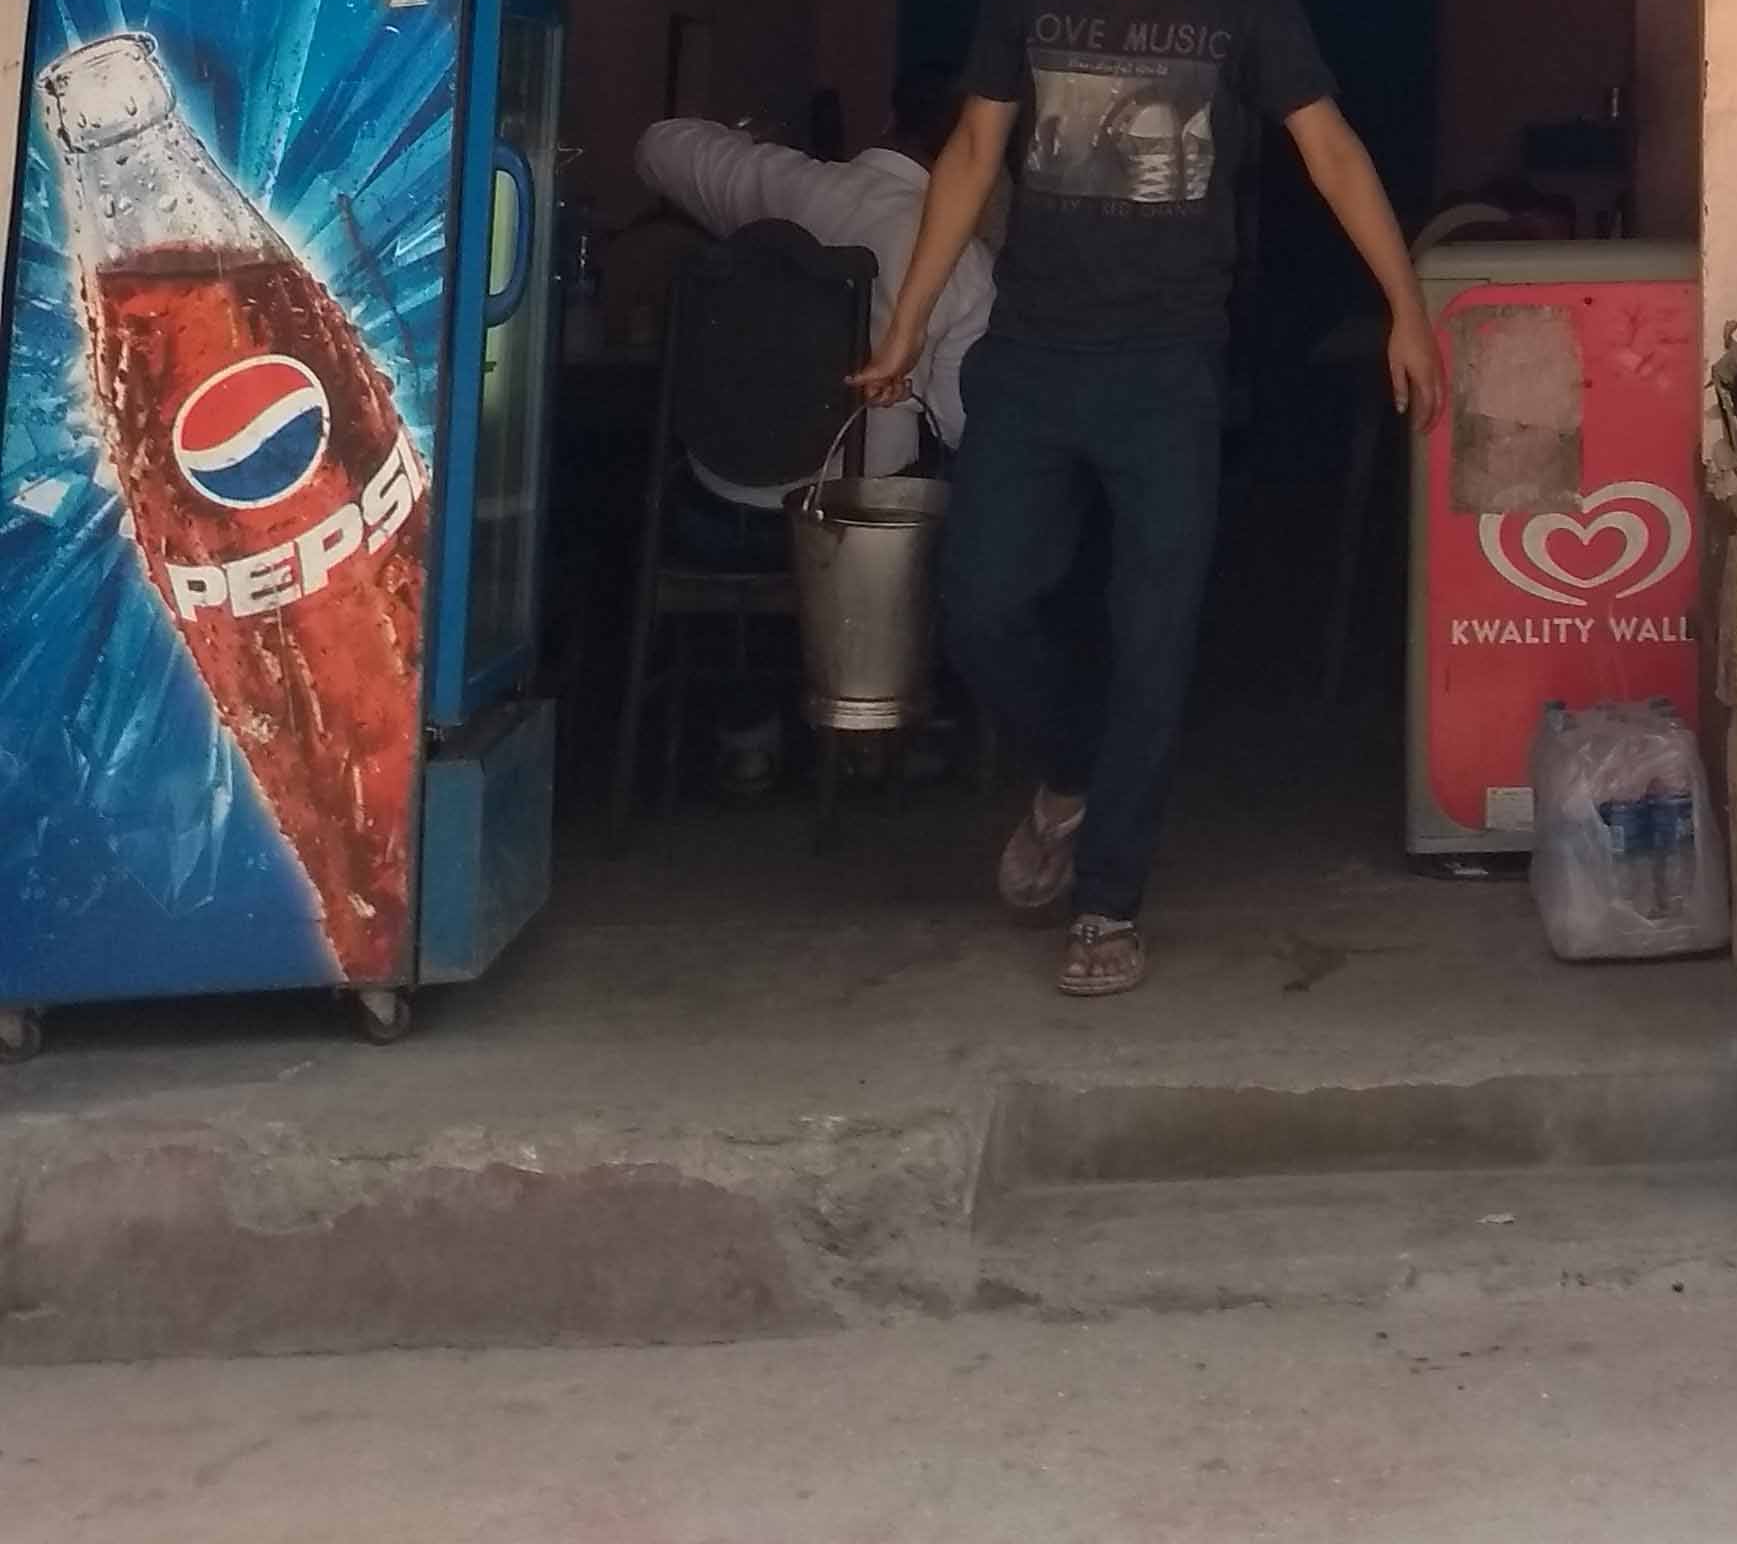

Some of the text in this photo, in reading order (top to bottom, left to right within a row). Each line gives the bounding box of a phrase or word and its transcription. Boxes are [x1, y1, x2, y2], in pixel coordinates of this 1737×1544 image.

[1036, 13, 1232, 60] OVE MUSIC
[165, 428, 425, 622] PEPSI
[1451, 615, 1695, 645] KWALITY WALL
